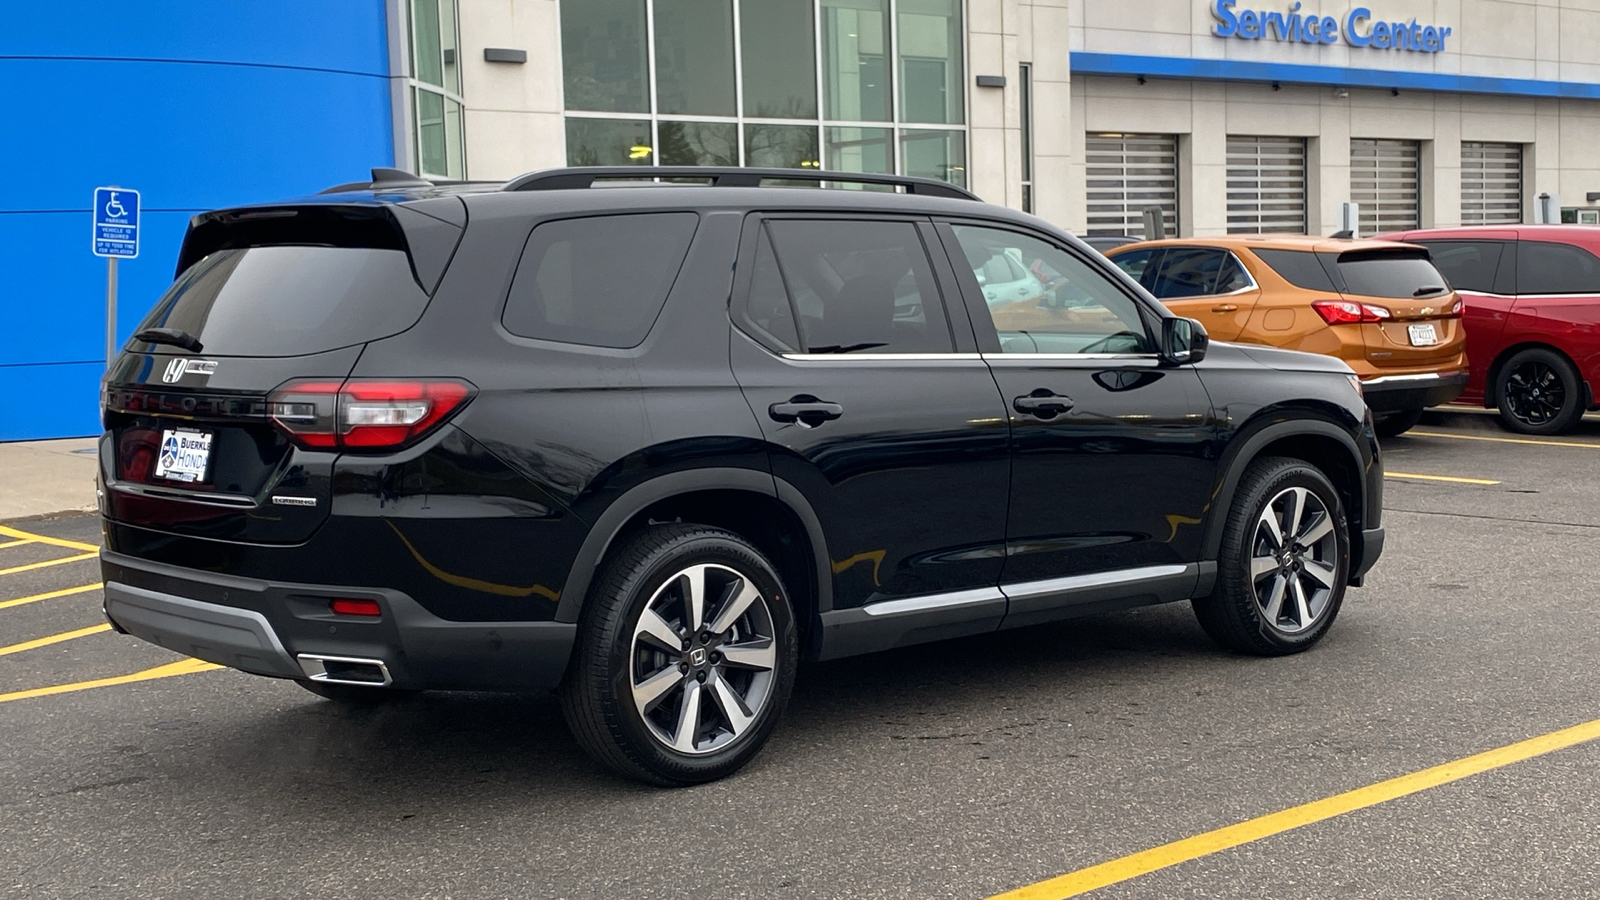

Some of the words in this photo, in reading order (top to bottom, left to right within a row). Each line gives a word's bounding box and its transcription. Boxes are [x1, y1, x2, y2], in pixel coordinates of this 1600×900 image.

[1212, 0, 1338, 45] Service
[1343, 7, 1452, 53] Center
[120, 392, 224, 413] PILOT
[180, 437, 211, 451] BUERKLE
[177, 449, 209, 469] HONDA
